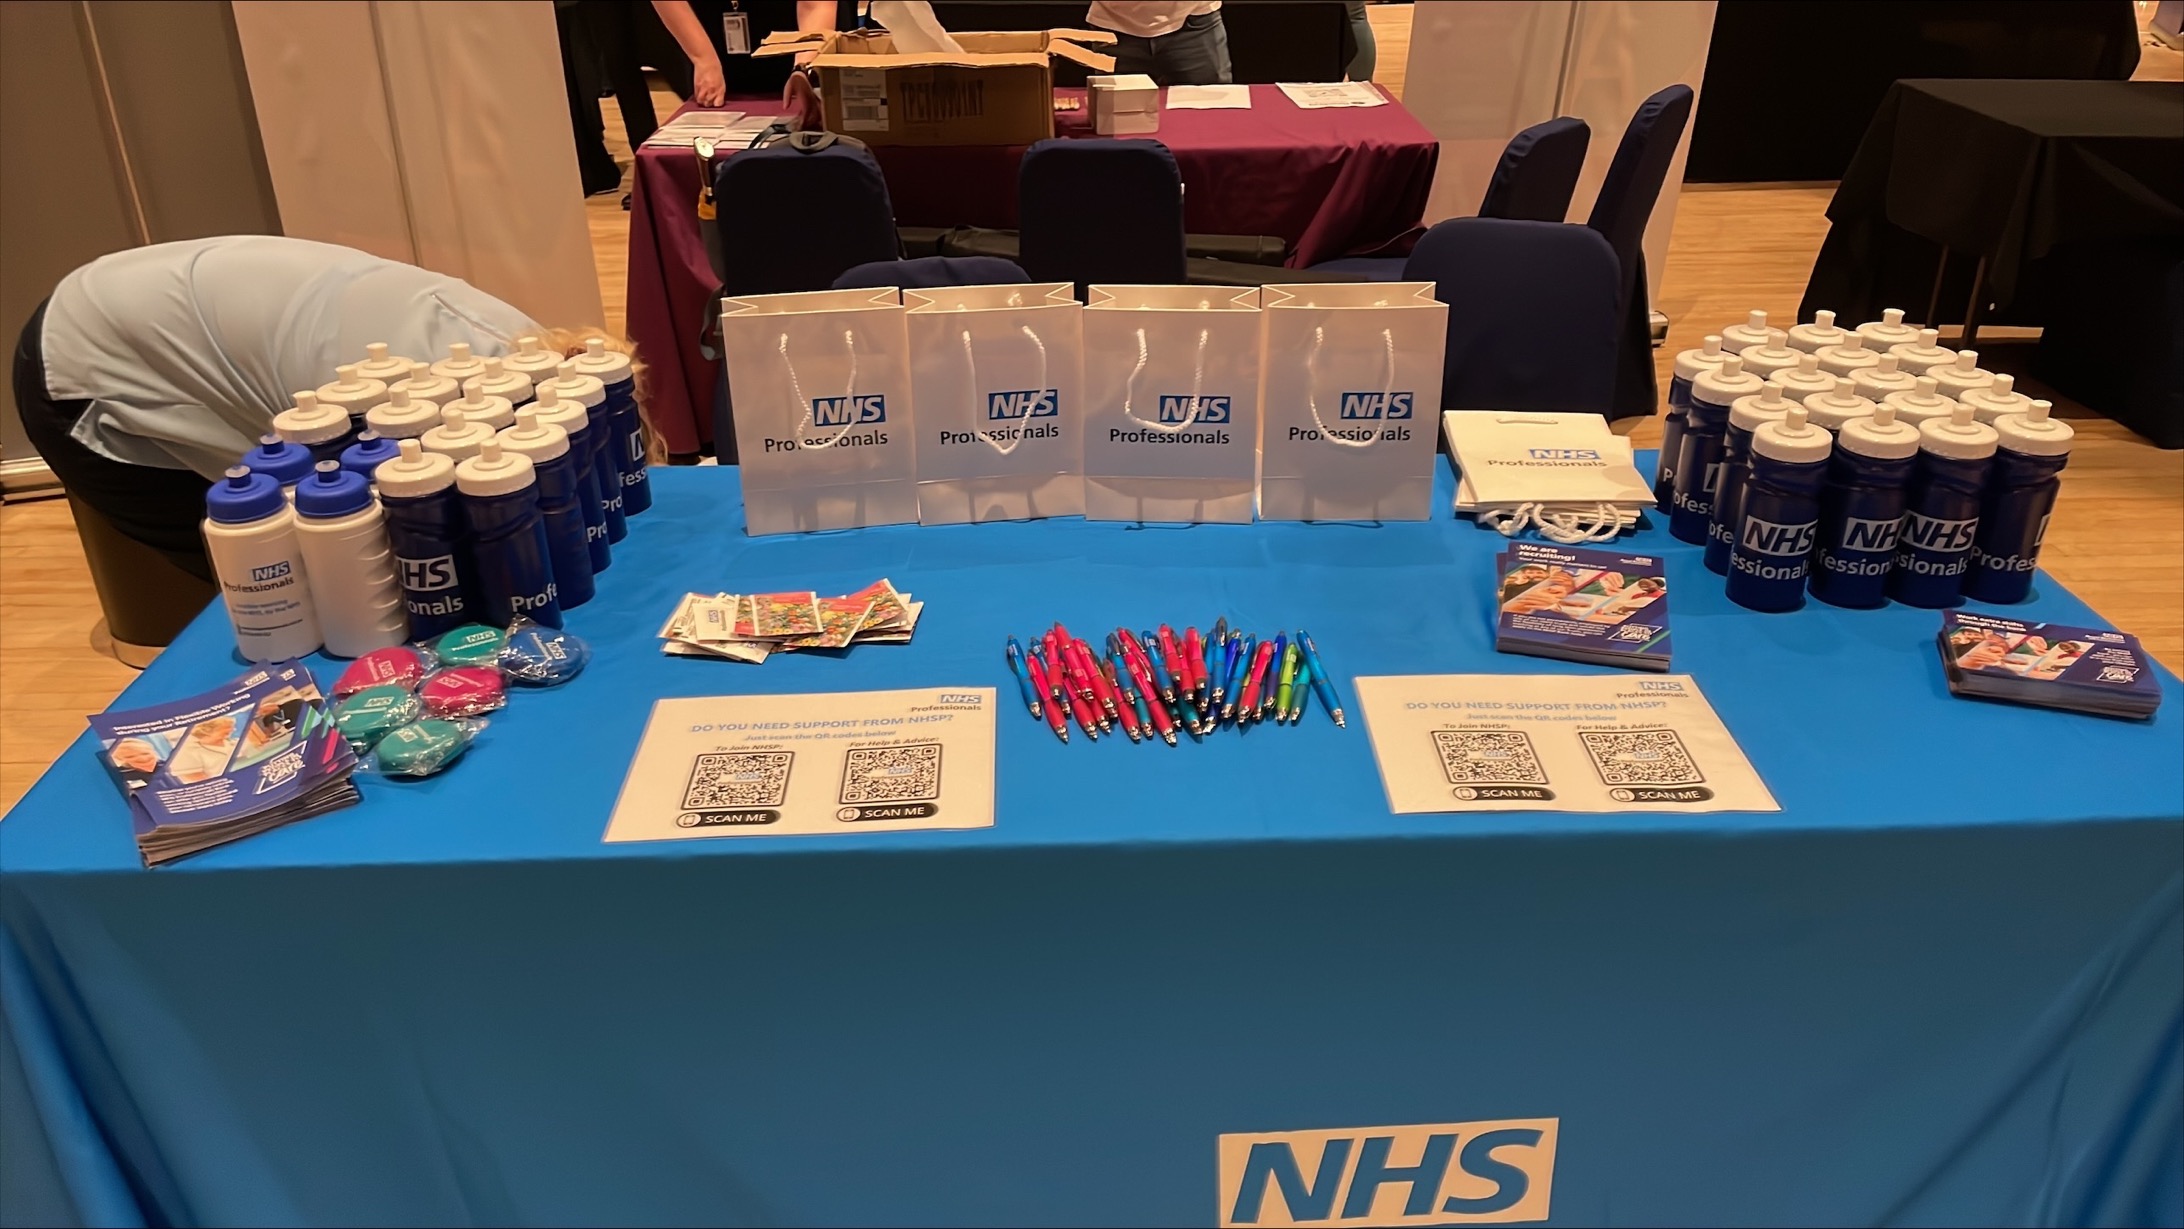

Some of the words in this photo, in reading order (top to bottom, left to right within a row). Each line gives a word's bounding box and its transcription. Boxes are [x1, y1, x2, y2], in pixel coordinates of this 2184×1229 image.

[990, 391, 1056, 418] NHS
[1161, 397, 1228, 422] NHS
[1342, 394, 1411, 418] NHS
[815, 397, 882, 425] NHS
[764, 429, 888, 453] Proessionals
[1110, 428, 1230, 444] Professionals
[1532, 450, 1597, 459] NHS
[1487, 459, 1608, 468] Professionals
[1745, 520, 1816, 553] NHS
[1902, 514, 1977, 549] NHS
[1519, 544, 1538, 552] We
[1518, 550, 1576, 562] recruiting!
[254, 562, 289, 582] NHS
[400, 558, 450, 589] HS
[469, 631, 495, 643] NHS
[1643, 682, 1680, 690] NHS
[941, 695, 981, 703] NHS
[911, 704, 981, 712] Professionals
[1406, 702, 1428, 710] DO
[1466, 702, 1502, 710] NEED
[1507, 703, 1570, 711] SUPPORT
[1620, 701, 1667, 709] NHSP?
[691, 724, 713, 733] DO
[718, 723, 748, 731] YOU
[752, 722, 790, 730] NEED
[793, 719, 859, 730] SUPPORT
[863, 718, 904, 727] FROM
[908, 714, 954, 724] NHSP?
[832, 731, 863, 739] codes
[864, 730, 896, 738] below
[729, 744, 750, 752] Join
[868, 739, 891, 747] Help
[1481, 788, 1521, 798] SCAN
[1523, 789, 1542, 798] ME
[1638, 790, 1676, 800] SCAN
[1679, 789, 1701, 800] ME
[865, 808, 901, 818] SCAN
[904, 807, 925, 815] ME
[705, 815, 742, 823] SCAN
[745, 814, 767, 822] ME
[1229, 1127, 1545, 1225] NHS
